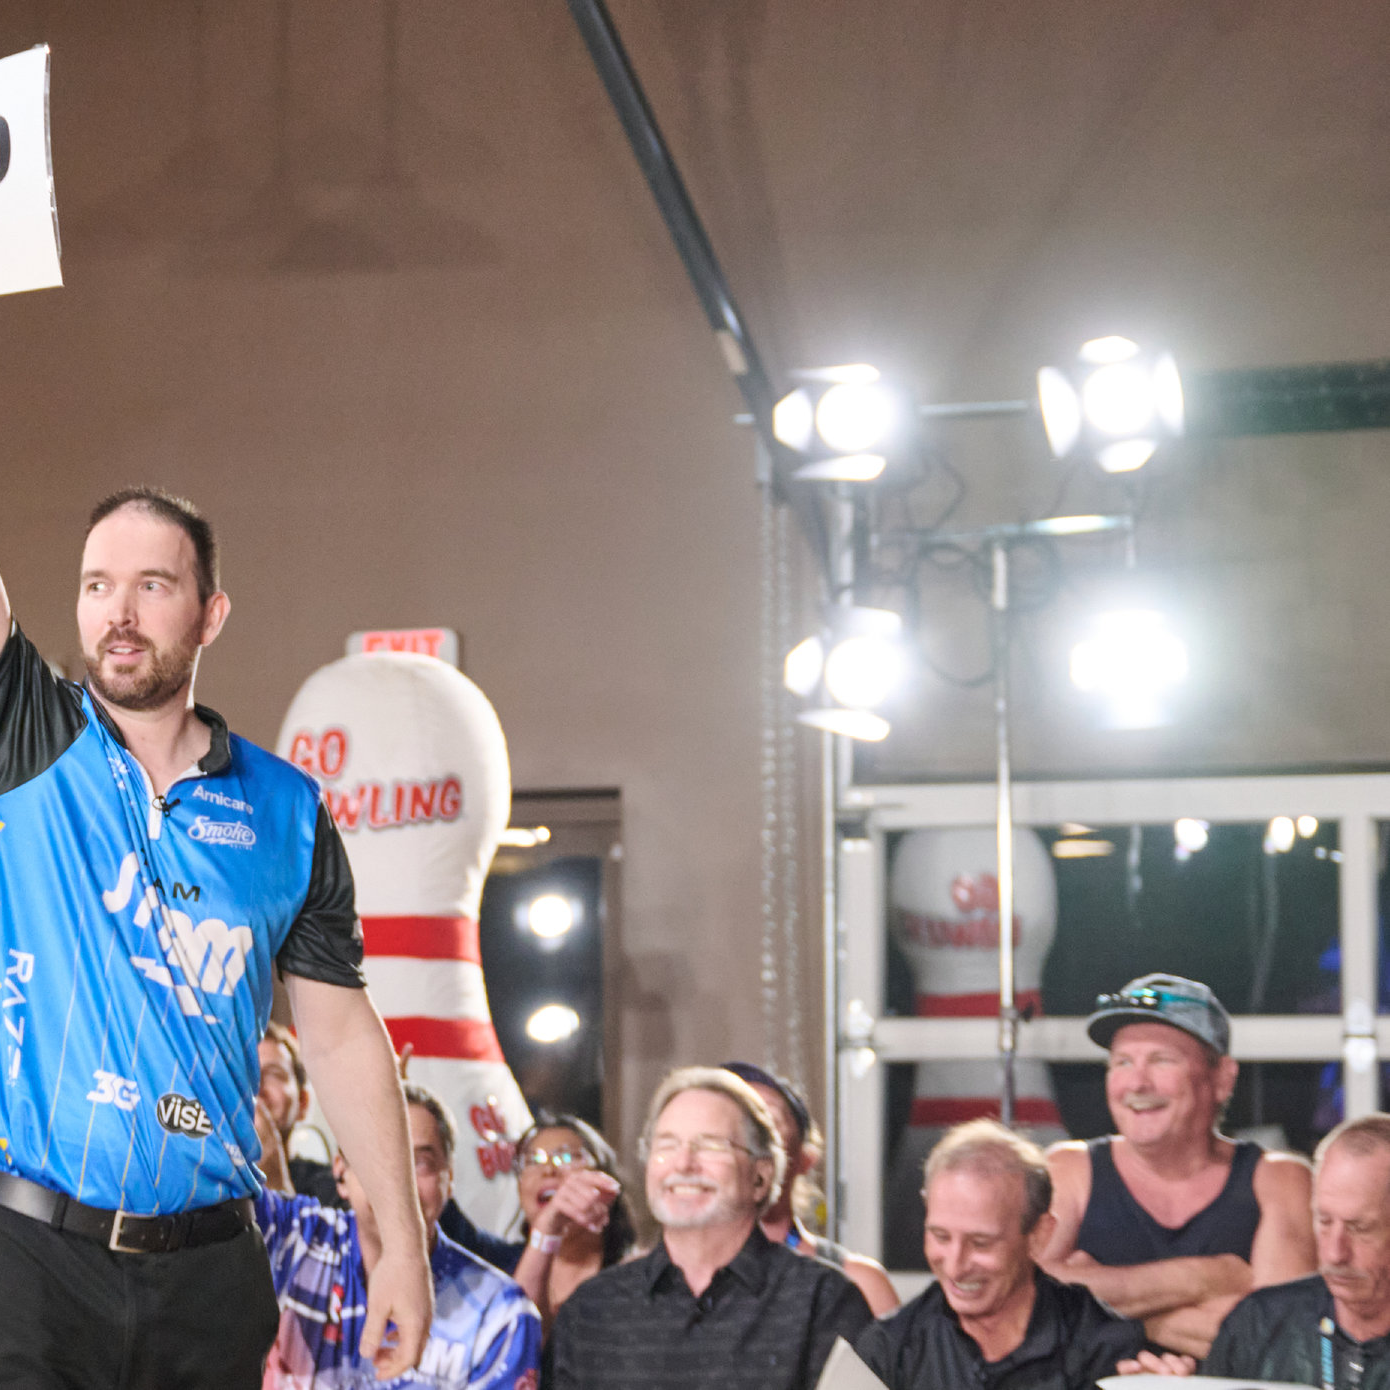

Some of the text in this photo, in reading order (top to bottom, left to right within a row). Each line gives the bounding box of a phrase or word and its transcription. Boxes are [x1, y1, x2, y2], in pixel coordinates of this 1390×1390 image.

[362, 630, 446, 658] EXIT
[289, 728, 348, 778] GO
[324, 775, 462, 830] WLING
[188, 814, 256, 844] Smoke
[86, 1069, 141, 1112] 3G
